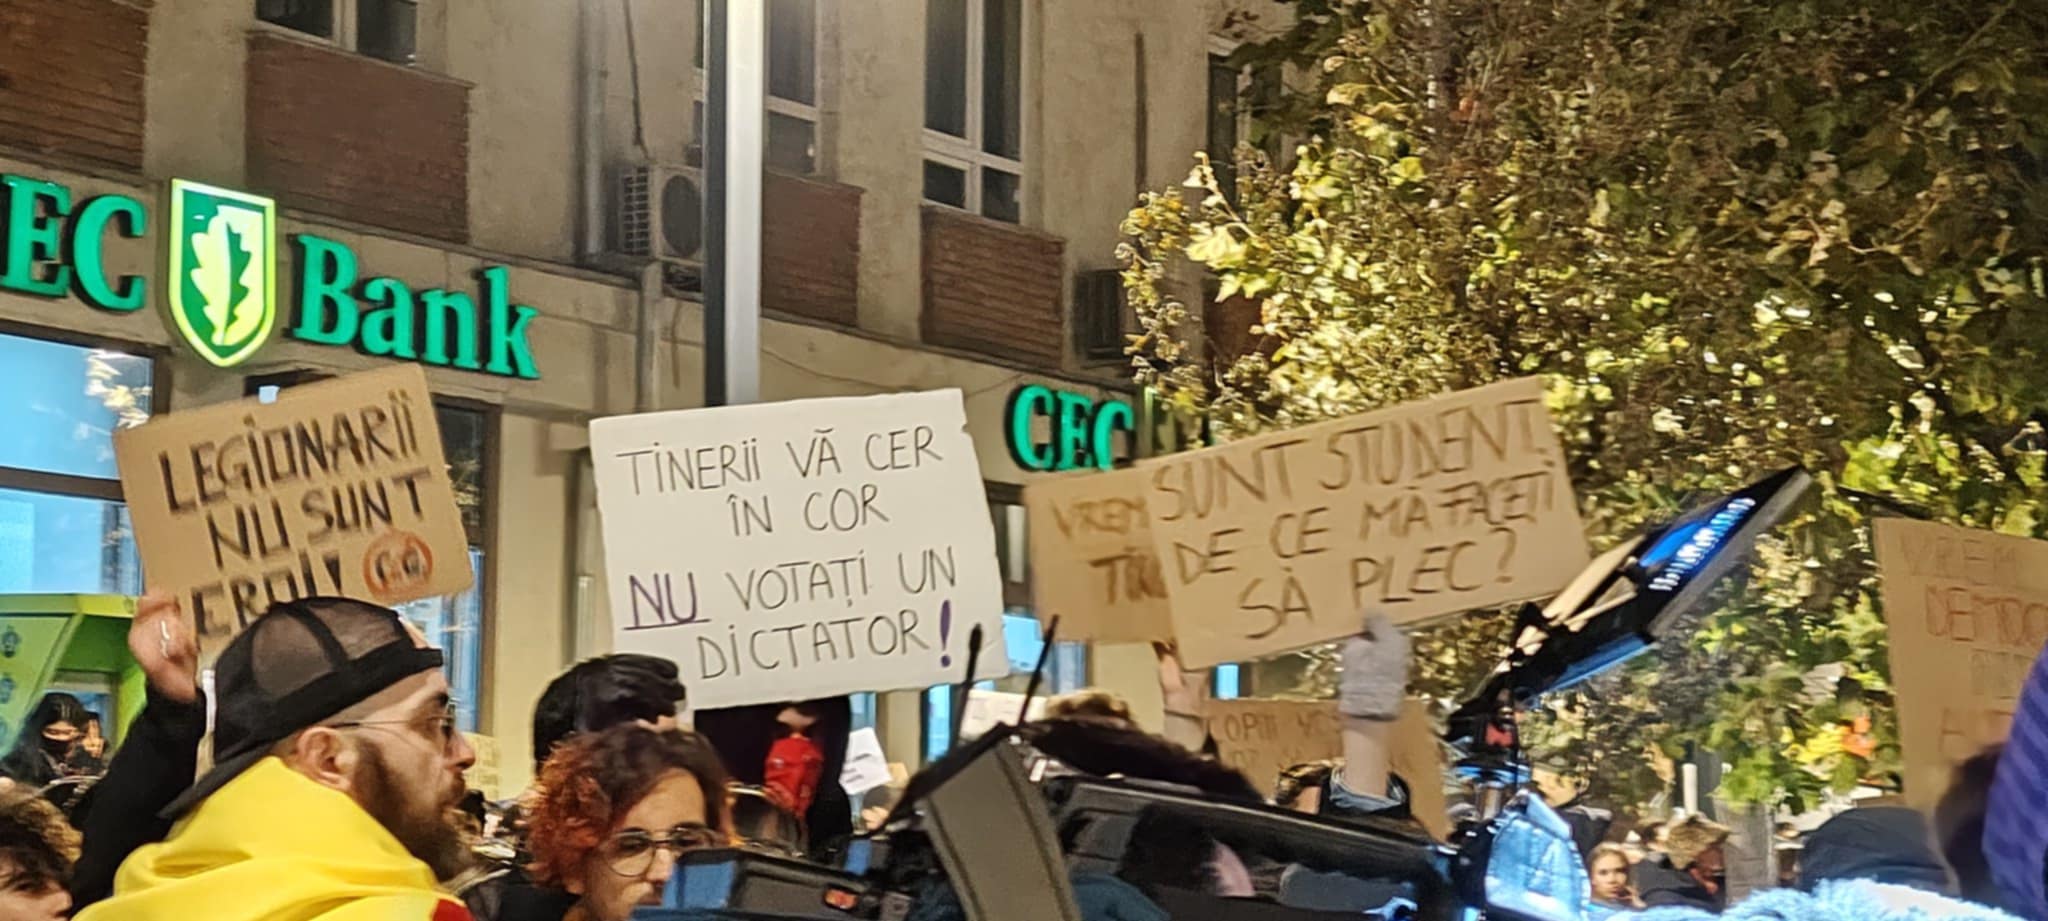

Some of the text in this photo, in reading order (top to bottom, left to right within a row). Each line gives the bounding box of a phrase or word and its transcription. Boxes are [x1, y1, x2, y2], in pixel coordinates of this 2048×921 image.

[293, 233, 540, 379] Bank
[158, 388, 421, 516] LEGIONARII
[616, 425, 944, 495] TINERII VĂ CER
[1013, 384, 1134, 472] CEC
[206, 466, 431, 573] NU SUNT
[727, 483, 890, 537] ÎN COR
[1152, 438, 1310, 521] SUNT
[1173, 528, 1243, 585] DE
[1269, 506, 1331, 559] CE
[627, 546, 957, 630] NU VOTAȚI UN
